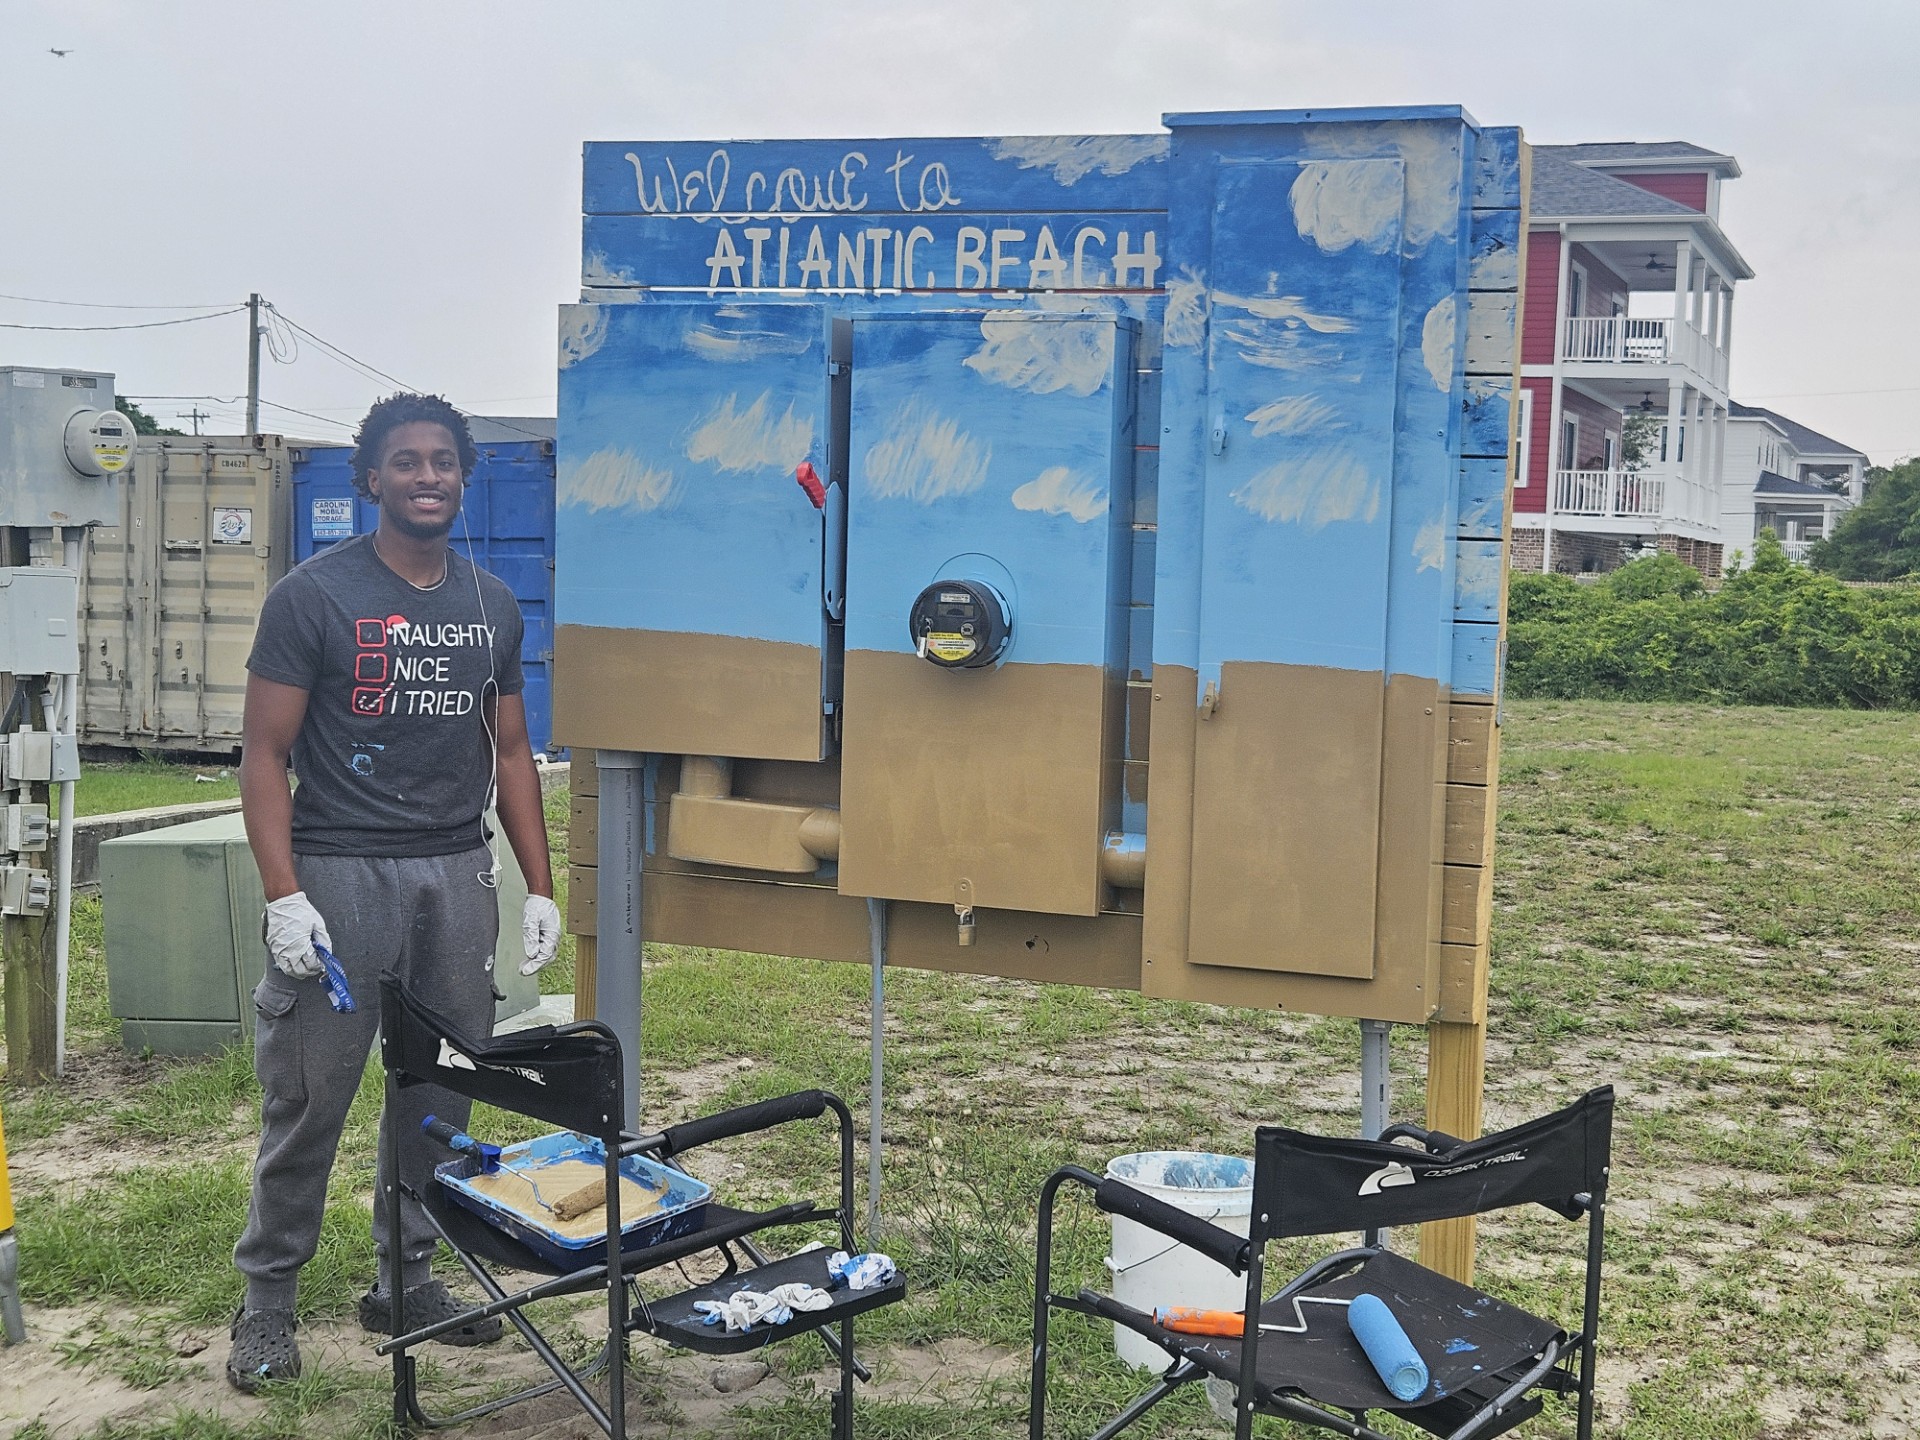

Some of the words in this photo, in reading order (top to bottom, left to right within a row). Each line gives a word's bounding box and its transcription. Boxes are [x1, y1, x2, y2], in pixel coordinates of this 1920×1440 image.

[885, 150, 961, 212] to
[705, 224, 934, 297] ATLANTIC
[955, 224, 1162, 299] BEACH
[314, 501, 350, 509] CAROLINA
[392, 622, 496, 648] NAUGHTY
[393, 656, 450, 682] NICE
[390, 690, 399, 715] I
[404, 690, 473, 715] TRIED
